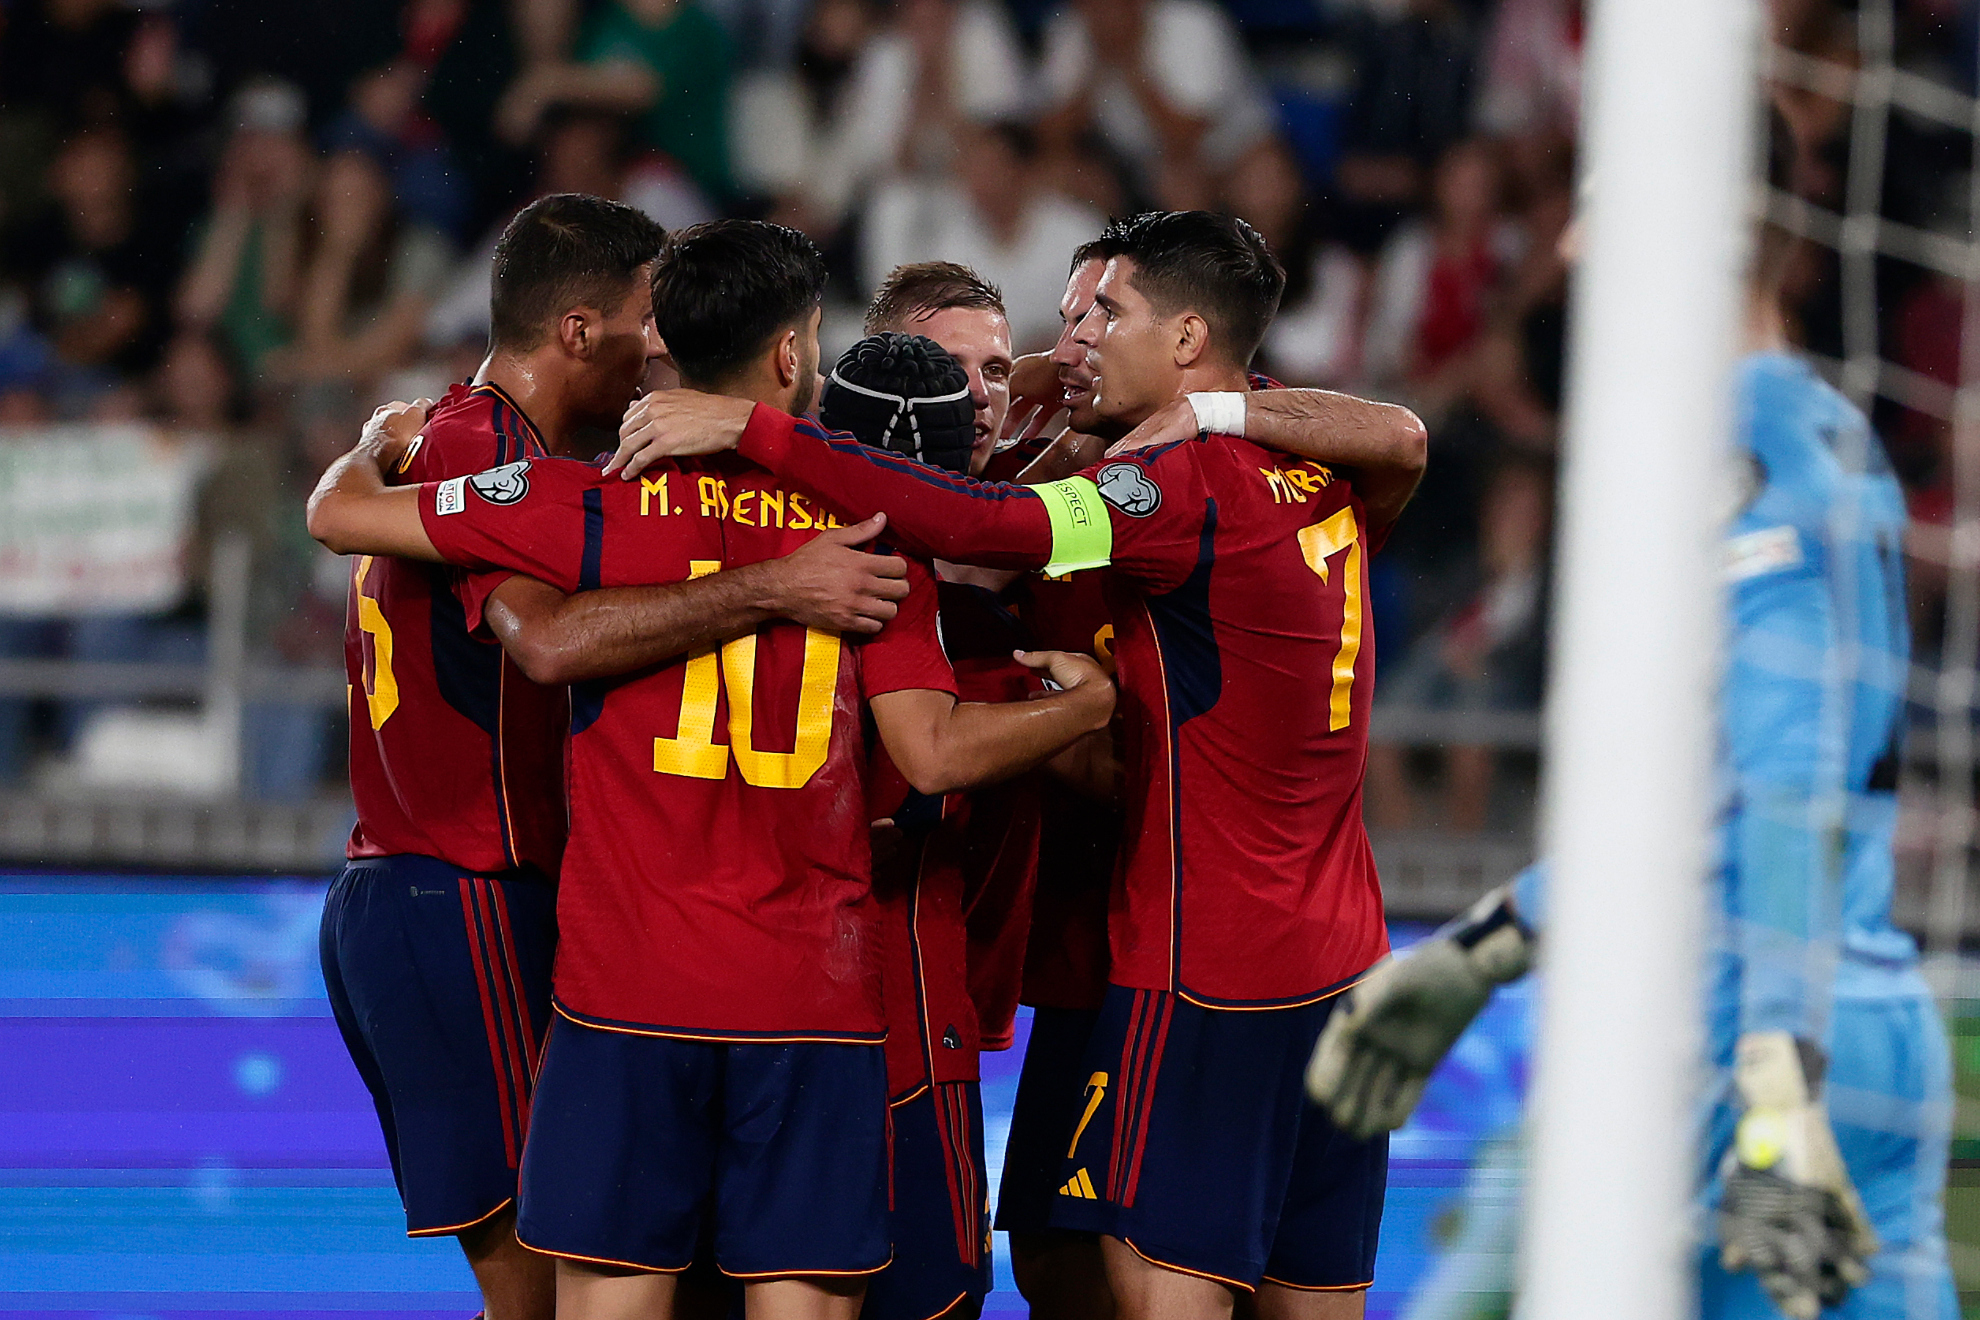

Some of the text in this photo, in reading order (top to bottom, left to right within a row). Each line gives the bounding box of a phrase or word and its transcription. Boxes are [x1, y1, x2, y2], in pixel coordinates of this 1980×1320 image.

[640, 472, 683, 516] M.
[653, 560, 842, 789] 10
[1297, 505, 1362, 732] 7
[1067, 1071, 1109, 1159] 7
